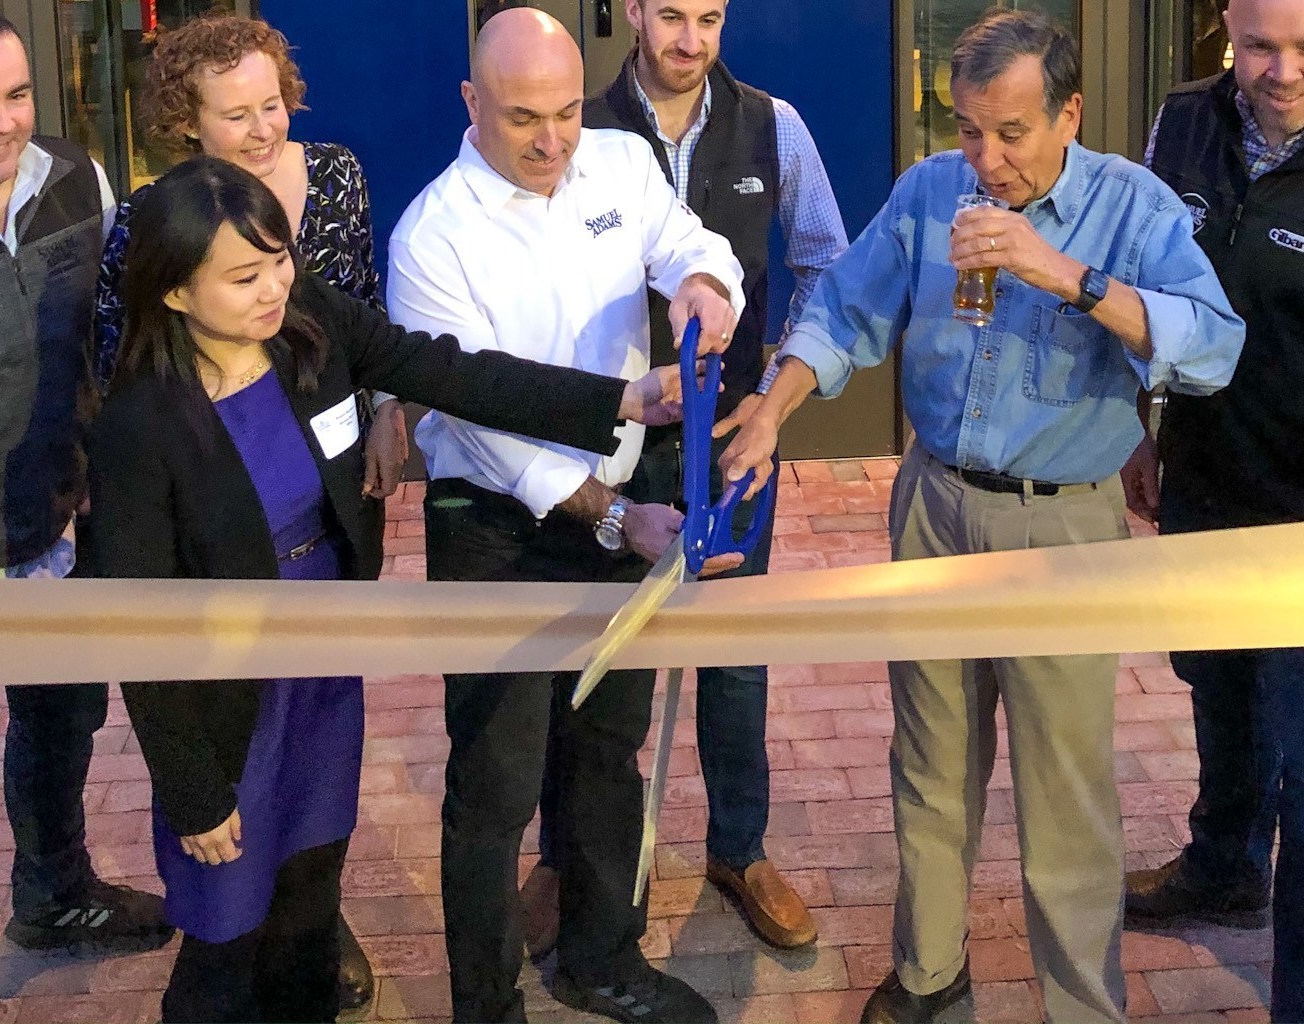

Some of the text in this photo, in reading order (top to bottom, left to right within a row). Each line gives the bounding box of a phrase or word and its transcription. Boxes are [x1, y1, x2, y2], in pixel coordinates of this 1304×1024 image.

[733, 182, 754, 190] NORTH
[585, 208, 622, 231] SAMUEL
[593, 216, 623, 239] ADAMS
